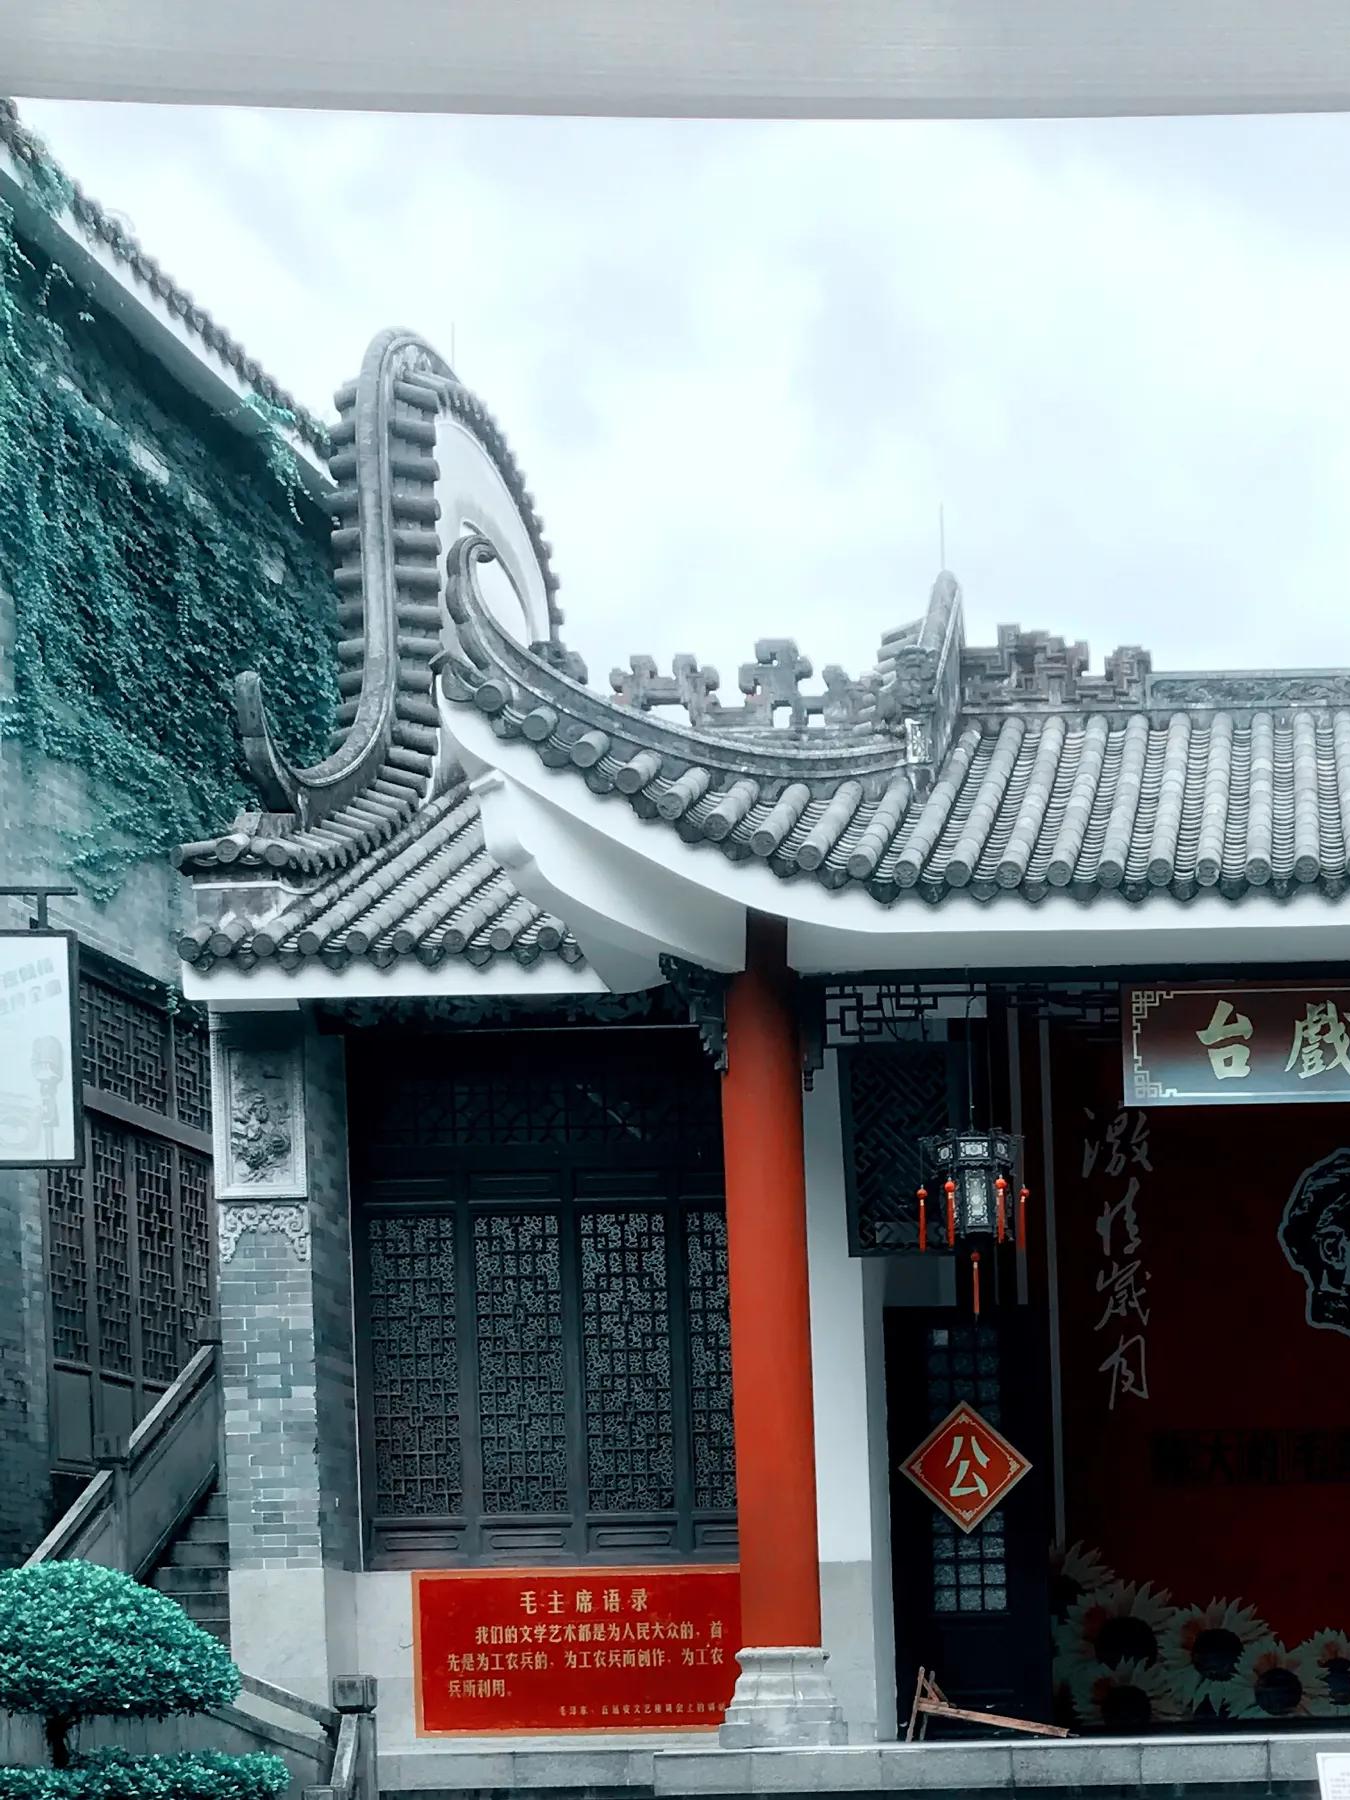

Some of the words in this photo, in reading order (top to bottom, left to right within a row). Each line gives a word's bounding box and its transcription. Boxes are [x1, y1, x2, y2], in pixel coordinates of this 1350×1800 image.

[945, 1436, 990, 1498] 公
[519, 1587, 648, 1615] 毛主席语录
